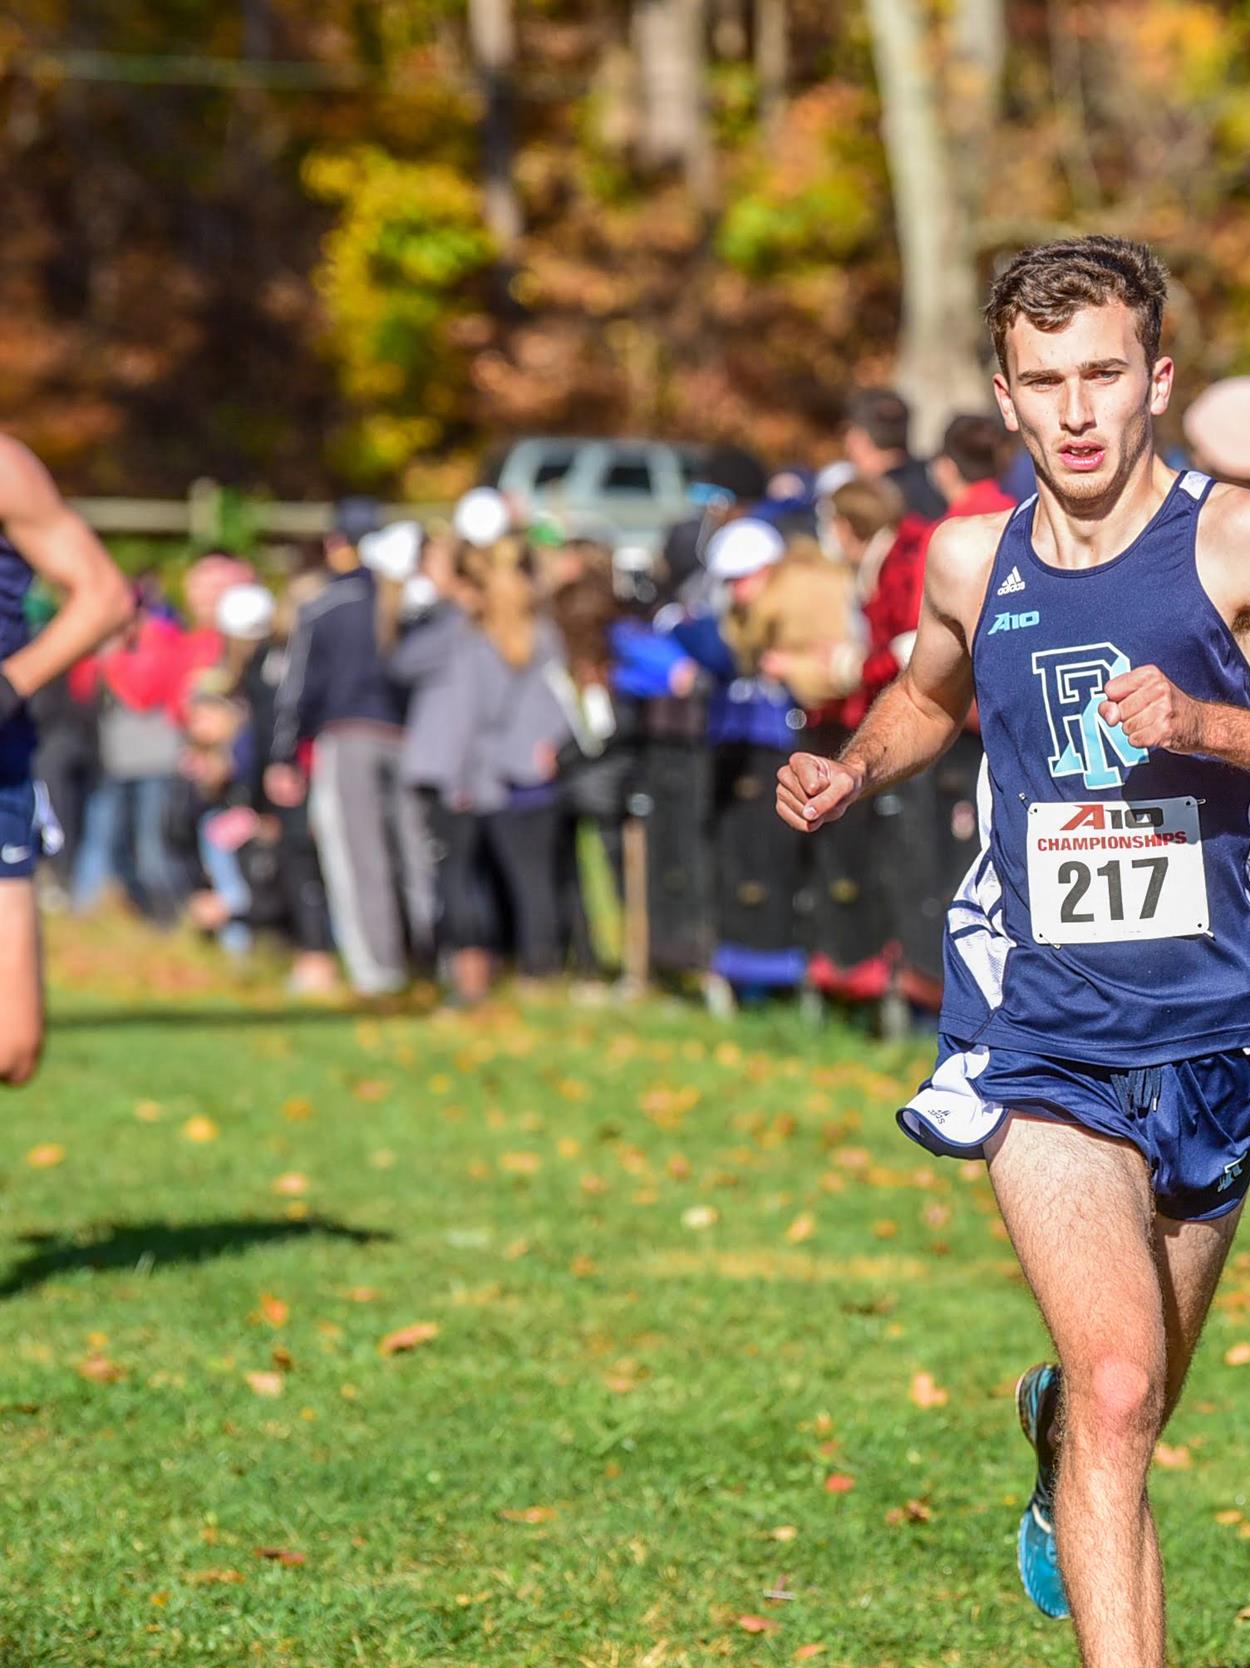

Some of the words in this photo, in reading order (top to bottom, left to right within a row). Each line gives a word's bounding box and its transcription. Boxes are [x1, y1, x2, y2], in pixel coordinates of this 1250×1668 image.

[987, 610, 1040, 635] A10
[1058, 804, 1164, 831] A10
[1037, 831, 1188, 852] CHAMPIONSHIPS
[1057, 856, 1170, 923] 217
